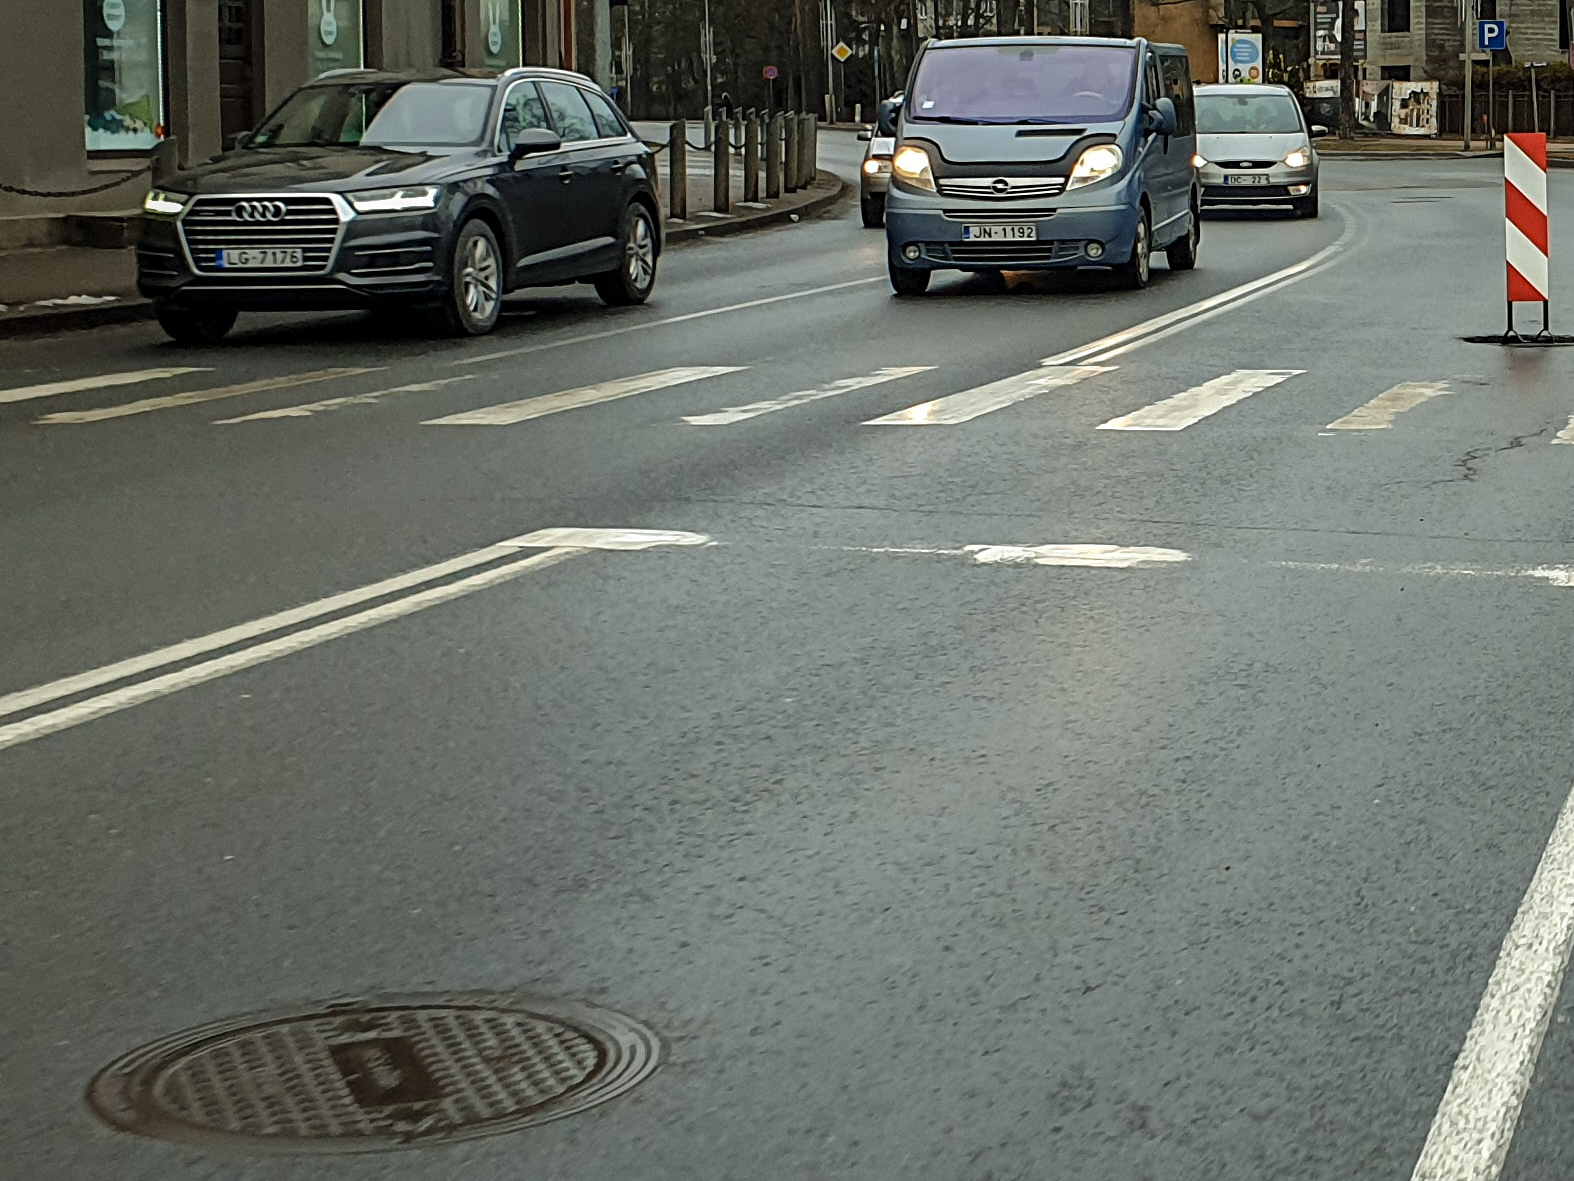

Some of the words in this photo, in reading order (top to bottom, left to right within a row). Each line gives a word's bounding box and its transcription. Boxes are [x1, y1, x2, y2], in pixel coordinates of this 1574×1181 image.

[1484, 24, 1499, 46] P
[973, 227, 1034, 239] JN-1192
[227, 251, 299, 266] LG-7176
